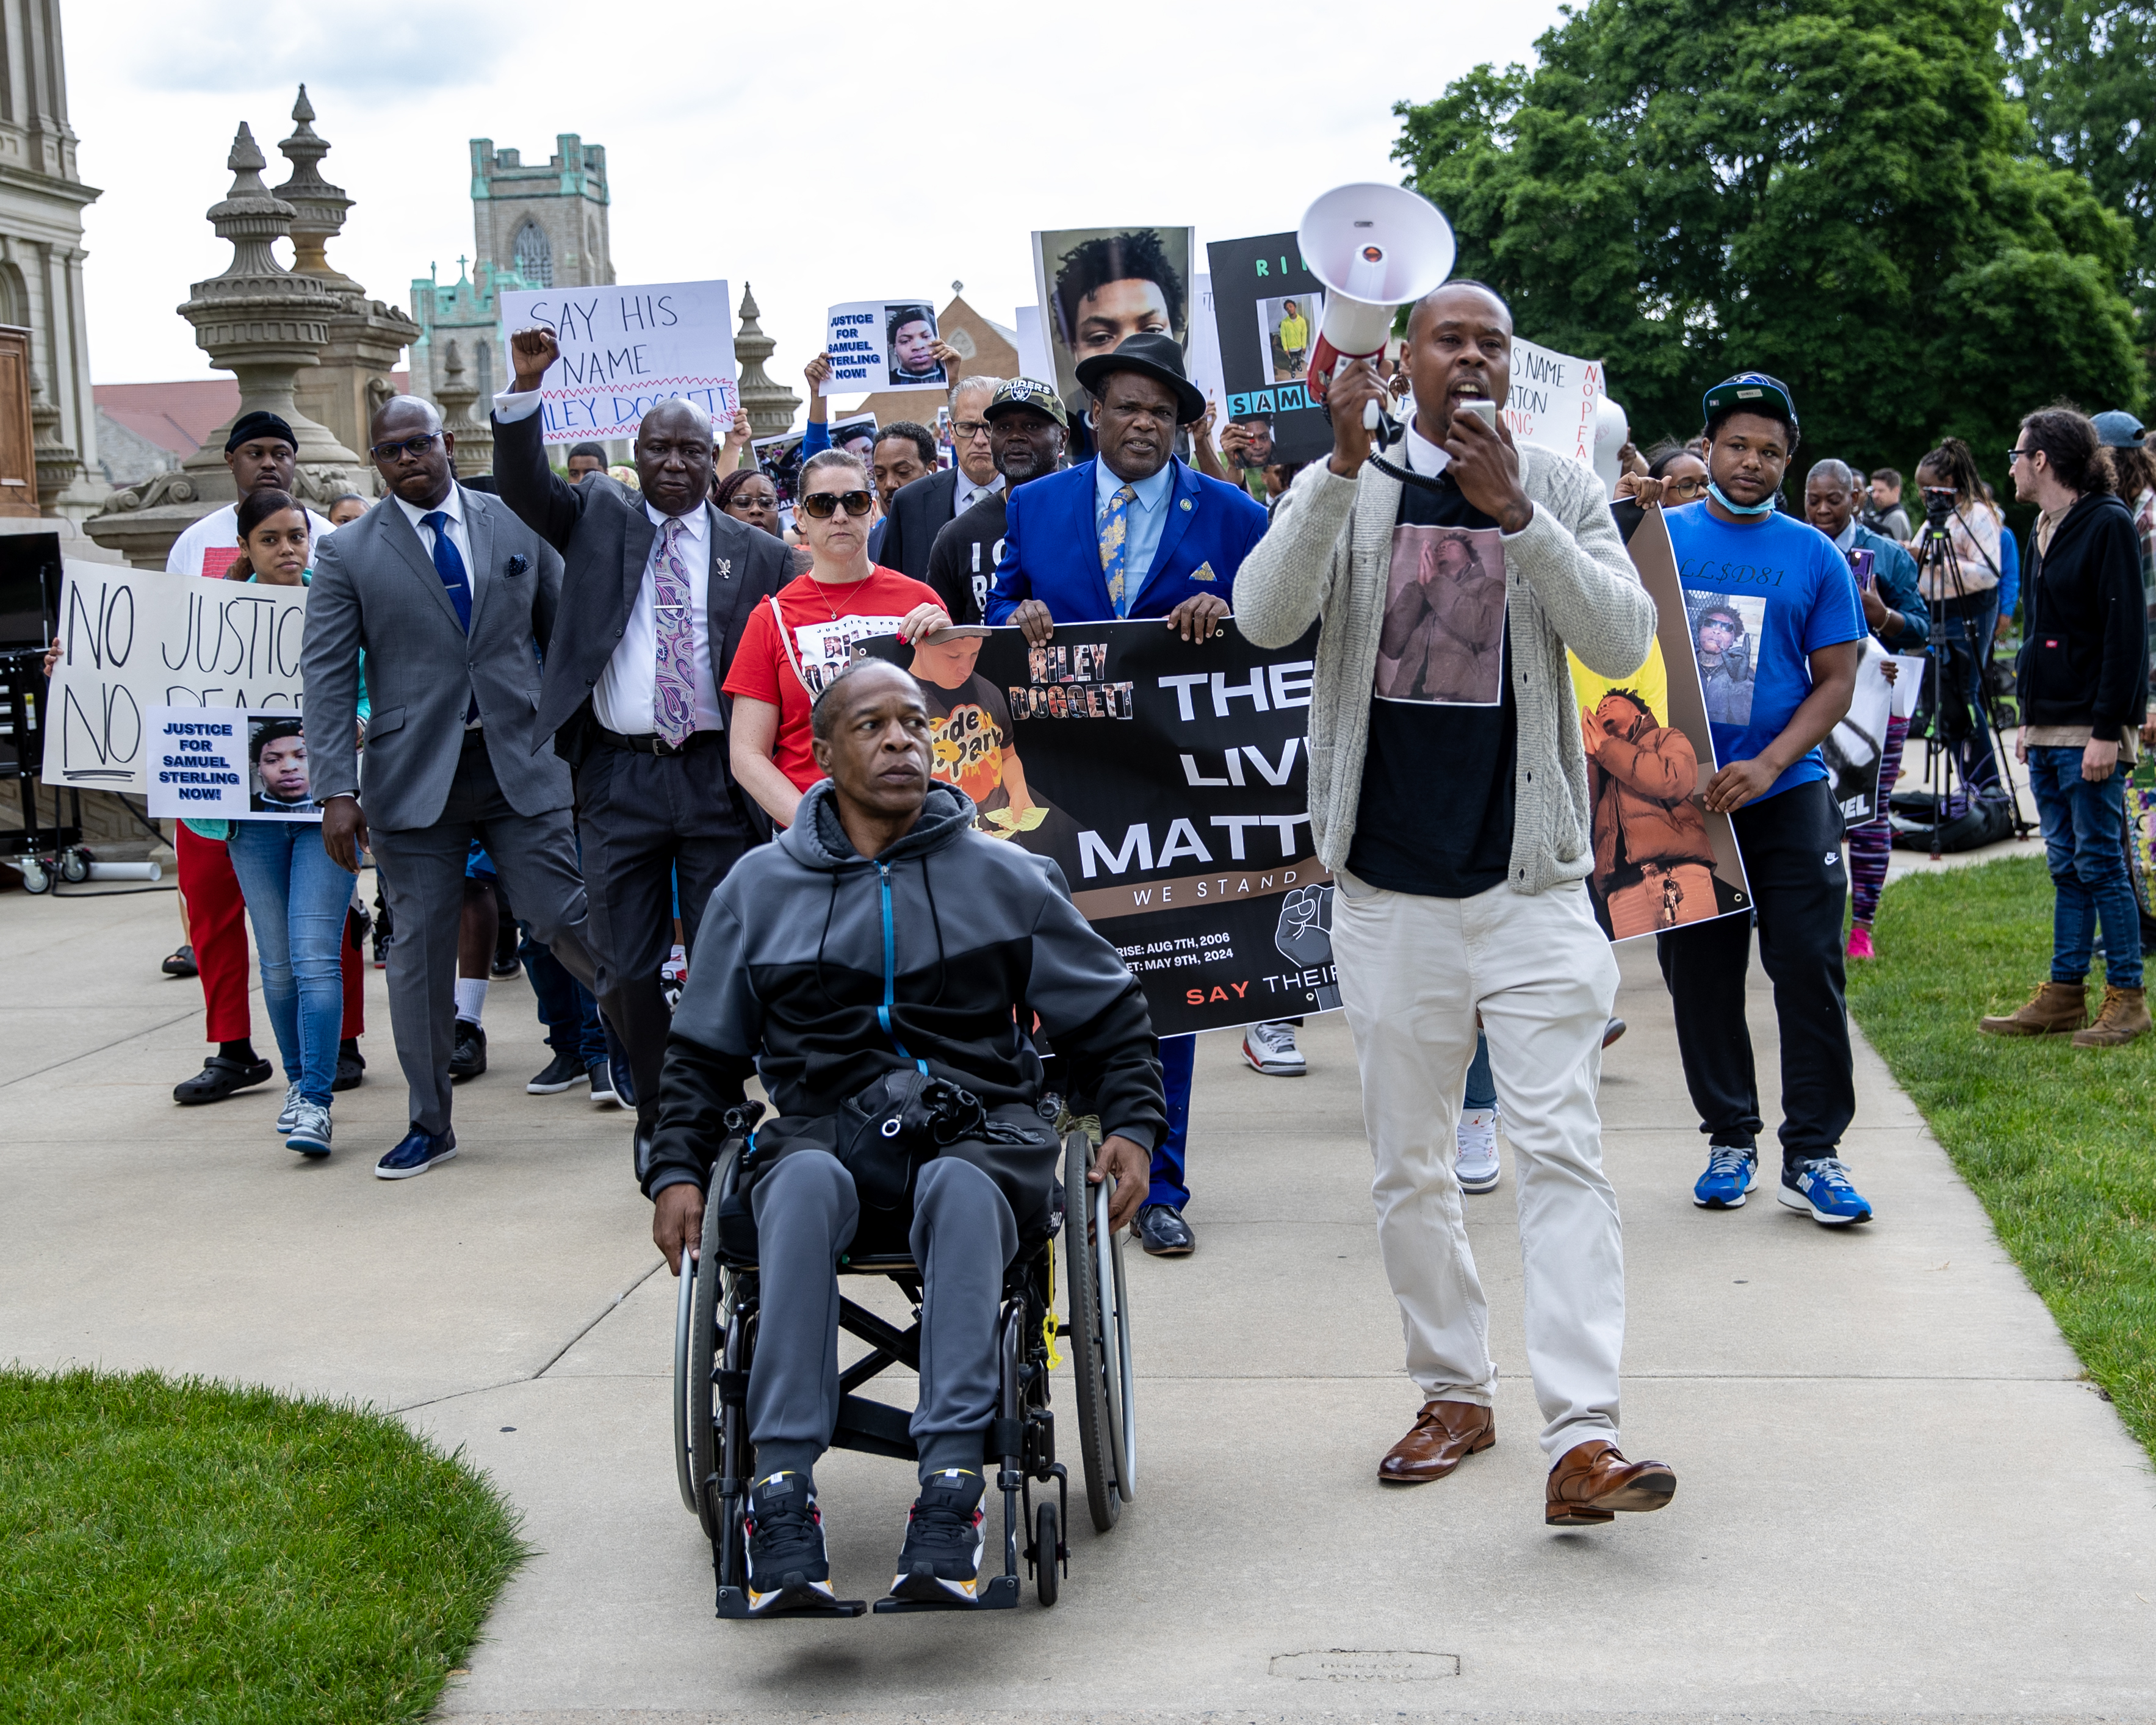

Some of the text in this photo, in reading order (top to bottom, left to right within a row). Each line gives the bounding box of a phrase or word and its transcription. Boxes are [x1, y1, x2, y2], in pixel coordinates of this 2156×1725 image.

[620, 295, 679, 331] HIS
[831, 314, 874, 328] JUSTICE
[836, 328, 859, 339] FOR
[828, 340, 873, 353] SAMUEL
[563, 345, 651, 387] NAME
[835, 368, 867, 380] NOW!
[1526, 351, 1565, 388] NAME
[997, 380, 1050, 395] RAIDERS
[1233, 389, 1317, 414] SAM
[67, 580, 134, 669] NO
[817, 620, 870, 633] JUSTICE
[1028, 643, 1108, 683] RILEY
[1009, 681, 1134, 721] DOGGETT
[64, 683, 141, 768] NO
[163, 722, 233, 736] JUSTICE
[179, 739, 212, 752] FOR
[163, 755, 230, 769] SAMUEL
[1179, 737, 1310, 786] LIV
[159, 771, 240, 785] STERLING
[178, 787, 222, 801] NOW!
[1133, 870, 1297, 907] WE STAND
[1147, 941, 1174, 954] AUG
[1174, 937, 1199, 949] 7TH,
[1200, 932, 1230, 946] 2006
[1144, 957, 1172, 970] MAY
[1174, 954, 1201, 967] 9TH,
[1204, 948, 1234, 962] 2024
[1186, 981, 1249, 1005] SAY
